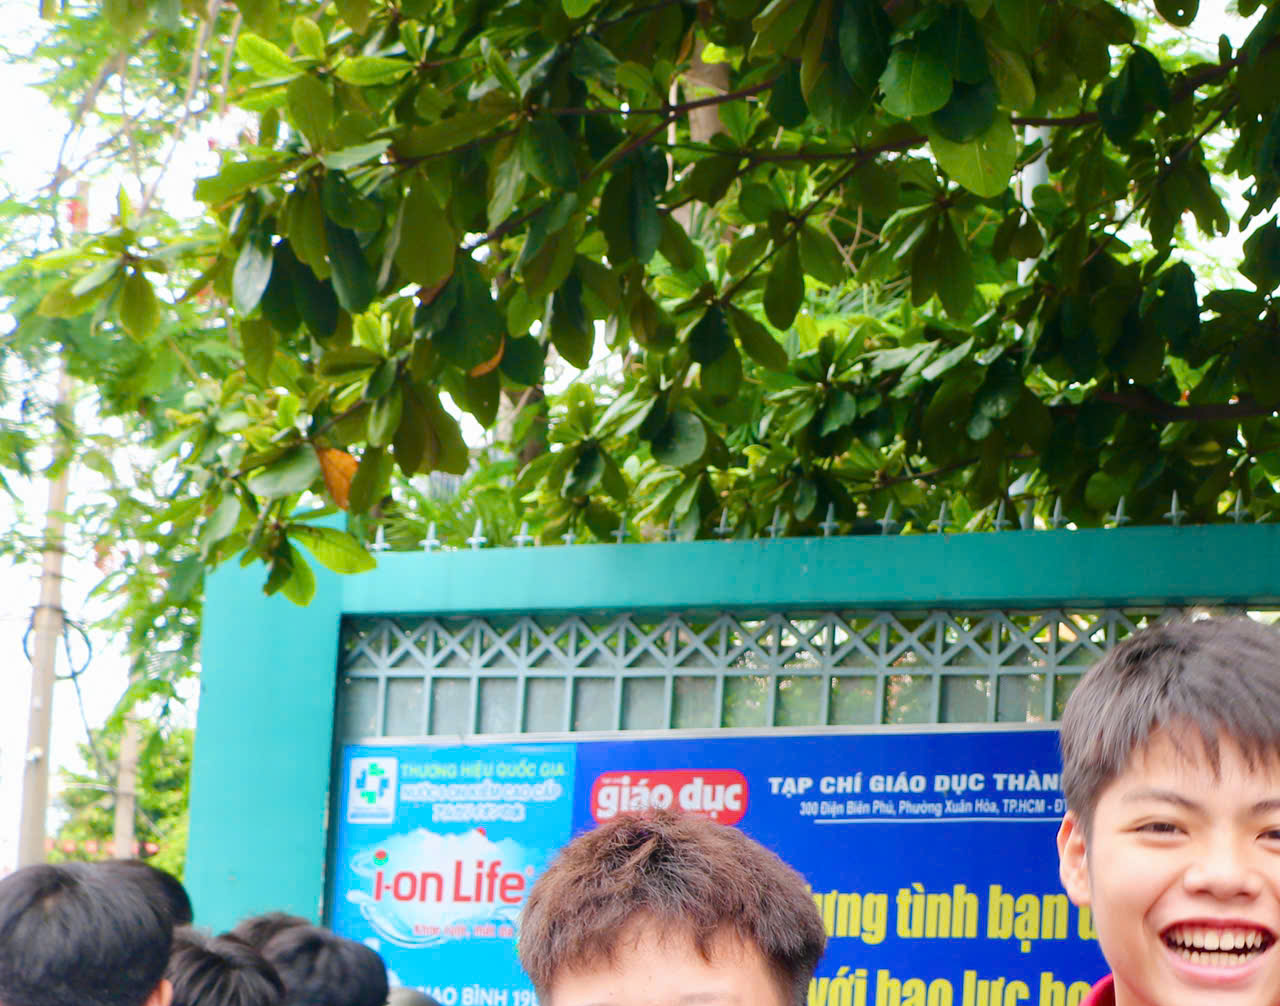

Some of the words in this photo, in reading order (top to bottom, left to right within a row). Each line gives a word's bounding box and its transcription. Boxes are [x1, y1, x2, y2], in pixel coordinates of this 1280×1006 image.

[597, 776, 673, 818] giáo
[679, 777, 743, 818] dục
[768, 776, 813, 798] TẠP
[820, 772, 862, 794] CHÍ
[869, 771, 926, 793] GIÁO
[934, 773, 985, 795] DỤC
[1002, 798, 1045, 814] TP.HCM
[374, 850, 443, 902] i-on
[453, 860, 525, 903] Life
[896, 883, 978, 938] tình
[987, 884, 1068, 953] bạn
